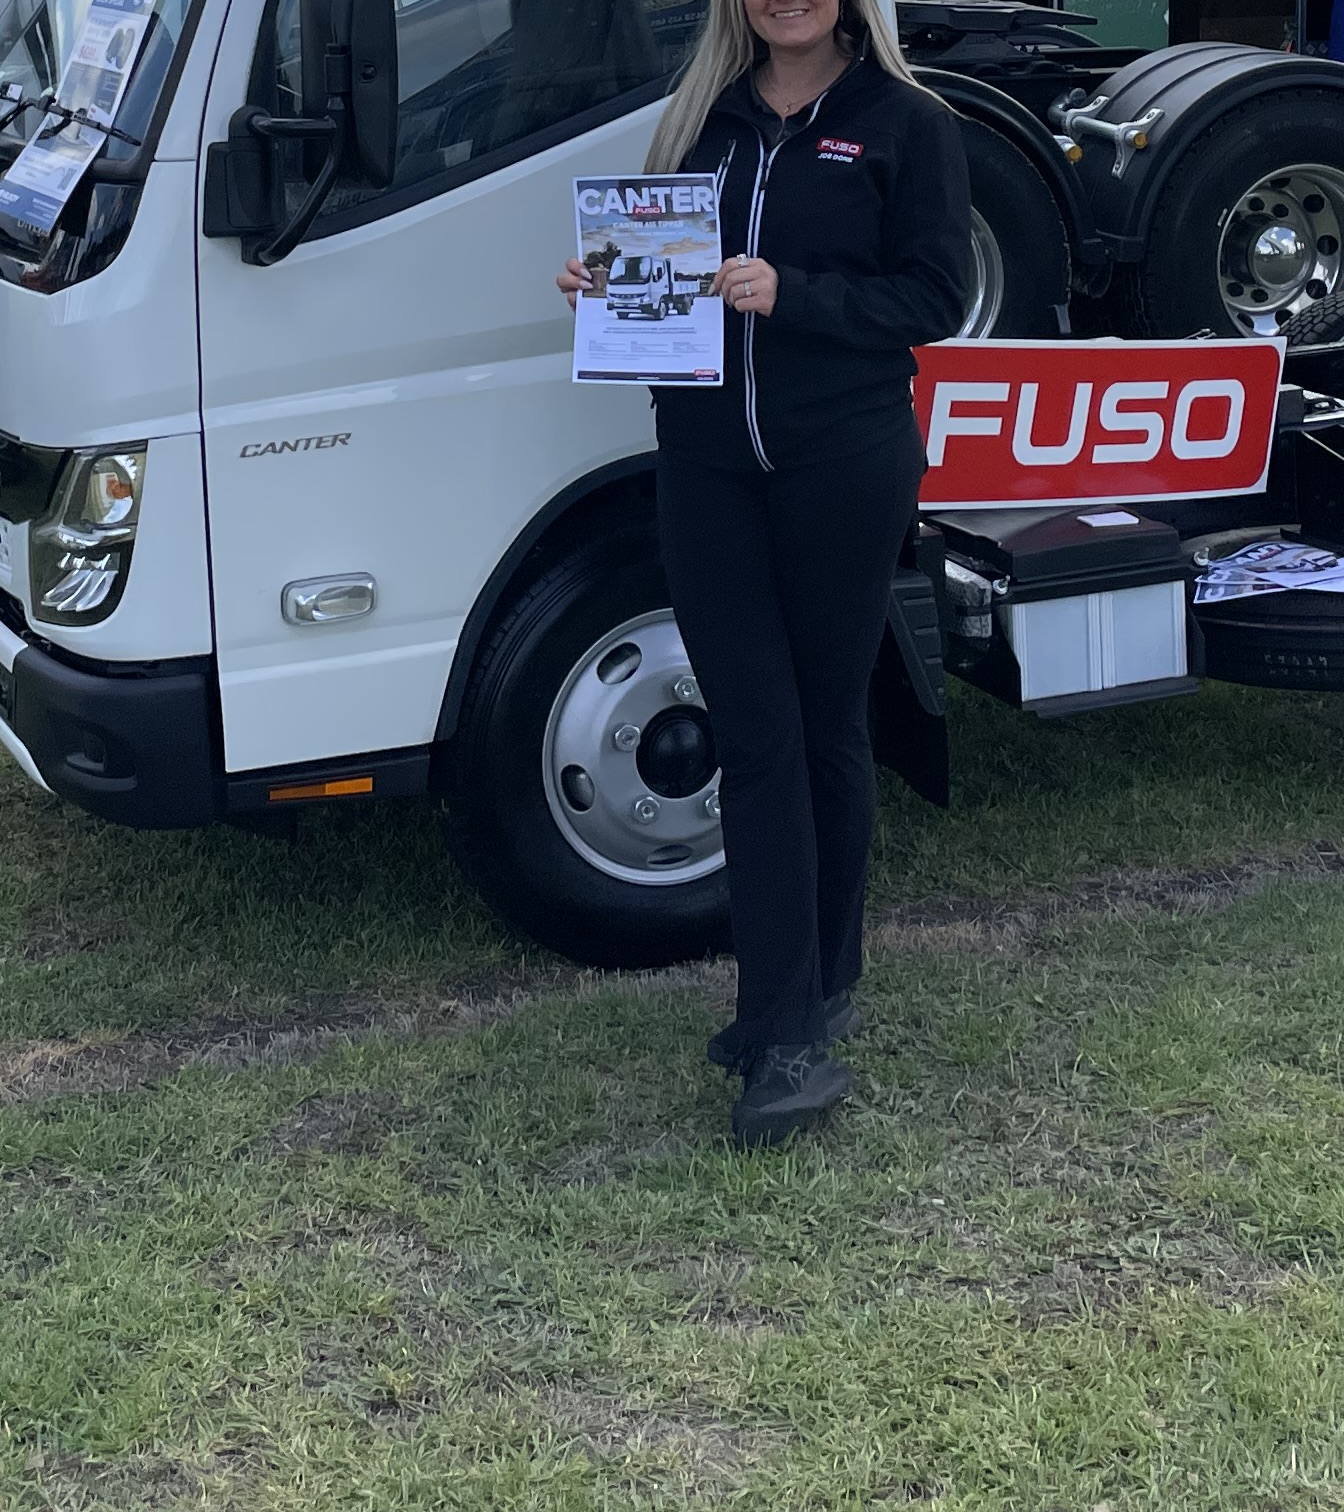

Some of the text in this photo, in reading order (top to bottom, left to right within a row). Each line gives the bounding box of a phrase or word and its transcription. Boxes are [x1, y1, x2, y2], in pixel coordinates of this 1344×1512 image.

[821, 140, 859, 153] FUSO
[578, 186, 714, 215] CANTER
[926, 378, 1246, 466] FUSO
[239, 432, 352, 458] CANTER
